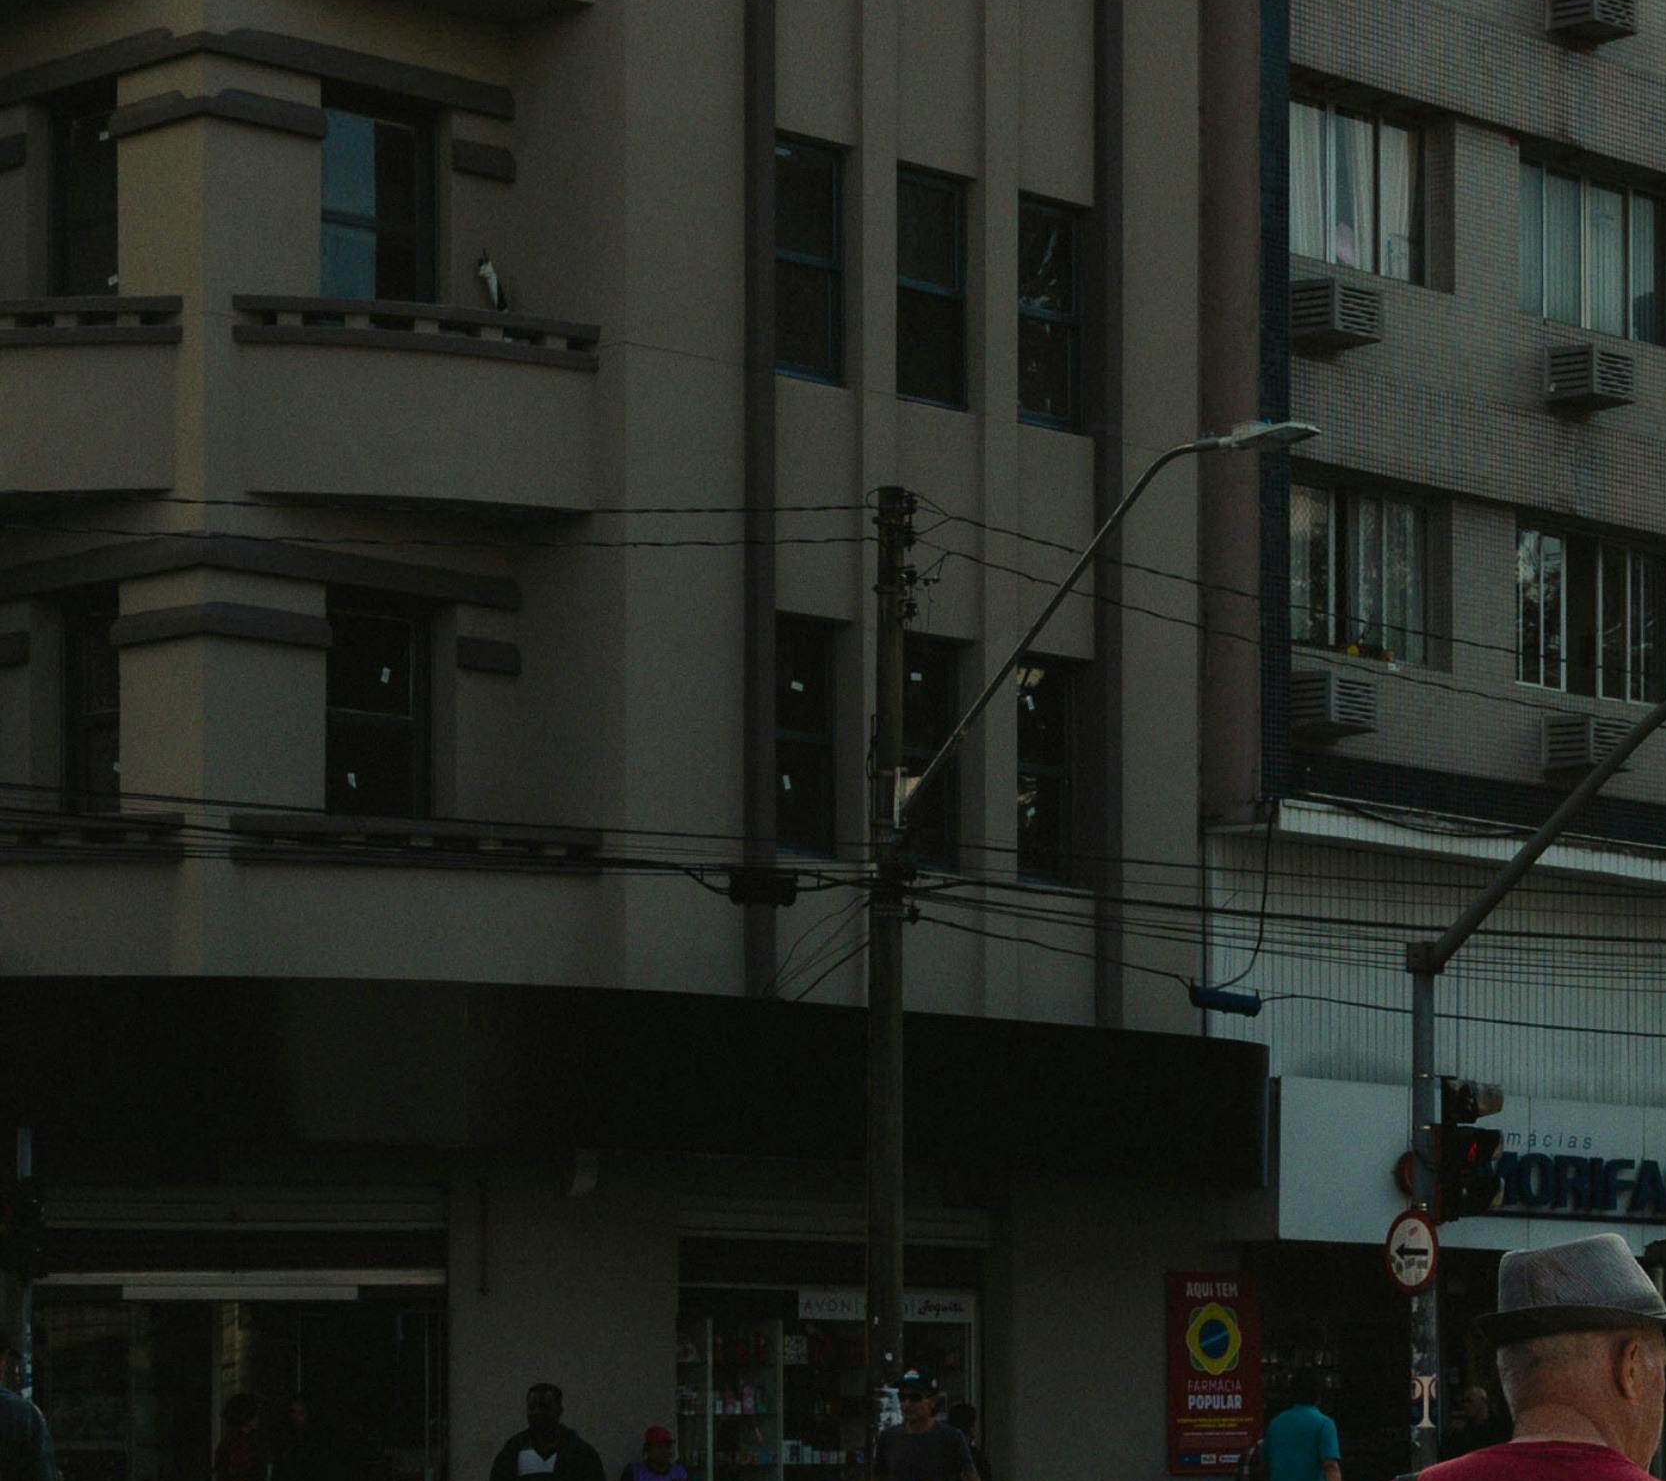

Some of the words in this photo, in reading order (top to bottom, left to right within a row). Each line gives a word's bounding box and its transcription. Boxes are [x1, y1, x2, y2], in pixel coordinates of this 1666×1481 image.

[1505, 1129, 1594, 1151] mácias
[1185, 1282, 1214, 1298] AQUI
[1215, 1282, 1238, 1298] TEM
[804, 1299, 850, 1313] AVON
[1187, 1379, 1243, 1393] FARMÁCIA
[1187, 1394, 1243, 1410] POPULAR
